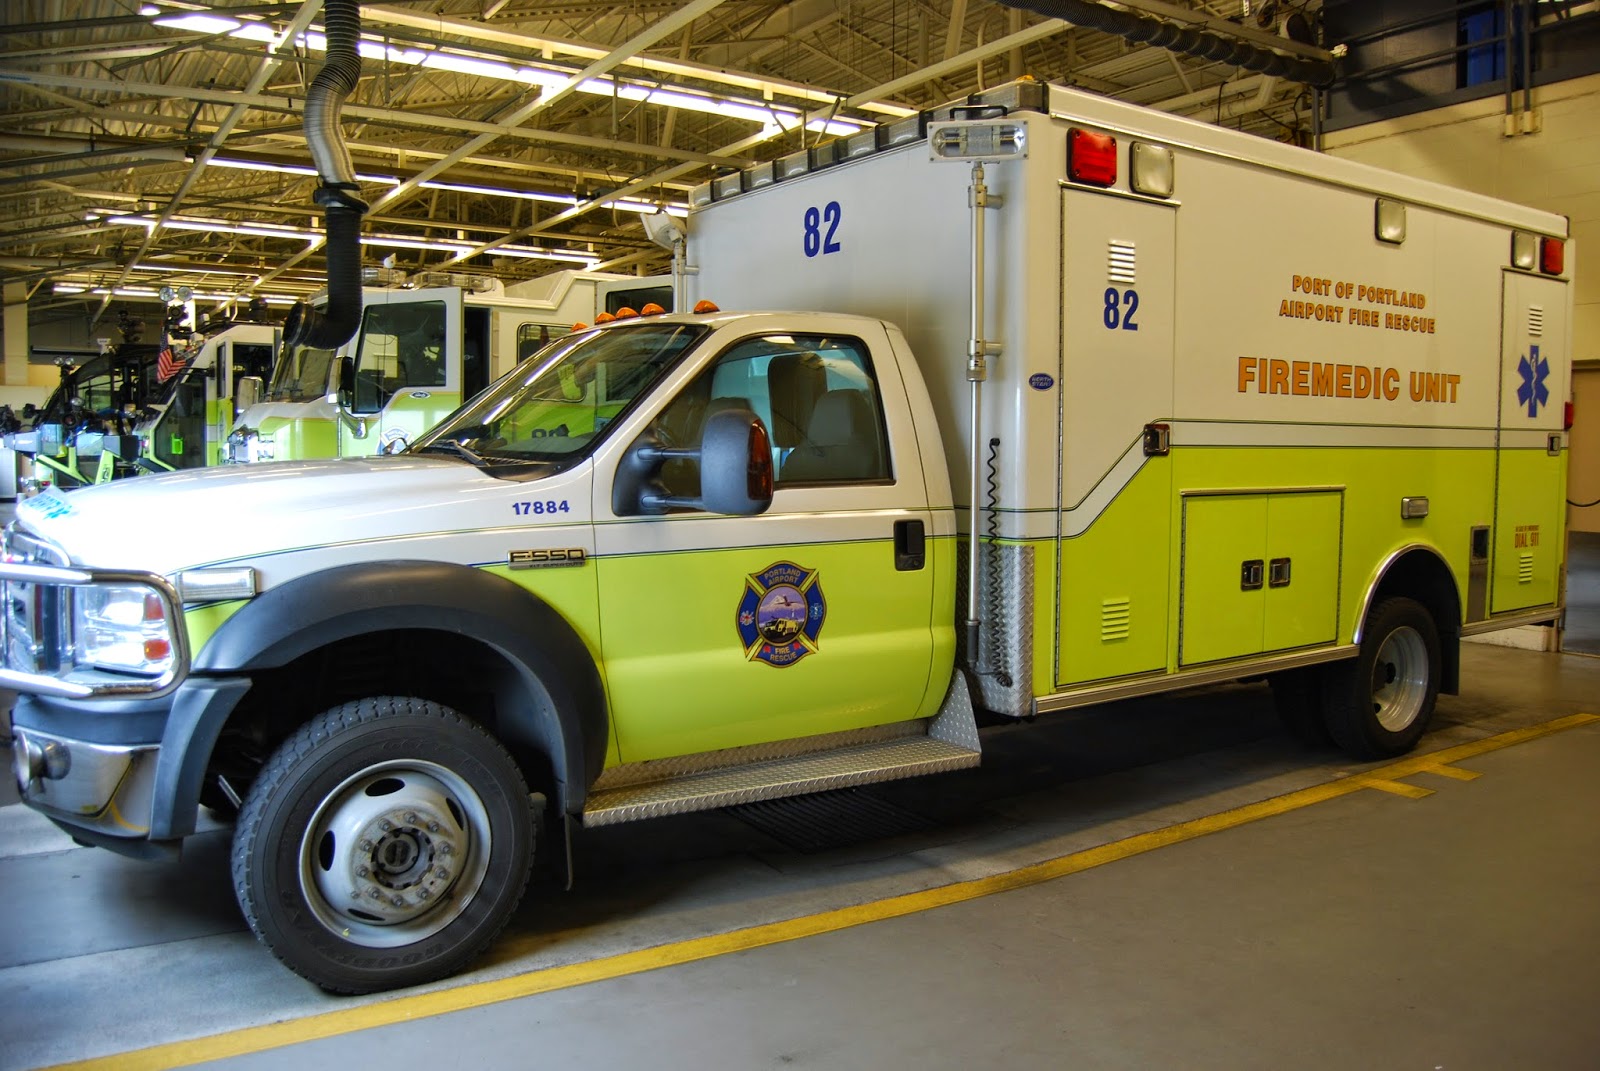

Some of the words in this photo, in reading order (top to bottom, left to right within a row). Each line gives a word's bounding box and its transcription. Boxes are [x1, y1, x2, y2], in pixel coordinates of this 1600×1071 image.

[804, 201, 841, 257] 82
[1292, 275, 1332, 297] PORT
[1335, 281, 1354, 299] OF
[1358, 284, 1426, 310] PORTLAND
[1103, 287, 1139, 331] 82
[1279, 299, 1344, 323] AIRPORT
[1348, 308, 1380, 328] FIRE
[1385, 312, 1436, 334] RESCUE
[1238, 356, 1400, 401] FIREMEDIC
[1409, 371, 1461, 404] UNIT
[512, 500, 570, 515] 17884
[1515, 532, 1528, 548] DIAL
[1530, 531, 1540, 547] 911
[764, 567, 801, 580] PORTLAND
[768, 575, 799, 586] AIRPORT
[769, 652, 798, 661] RESCUE
[774, 646, 791, 655] FIRE
